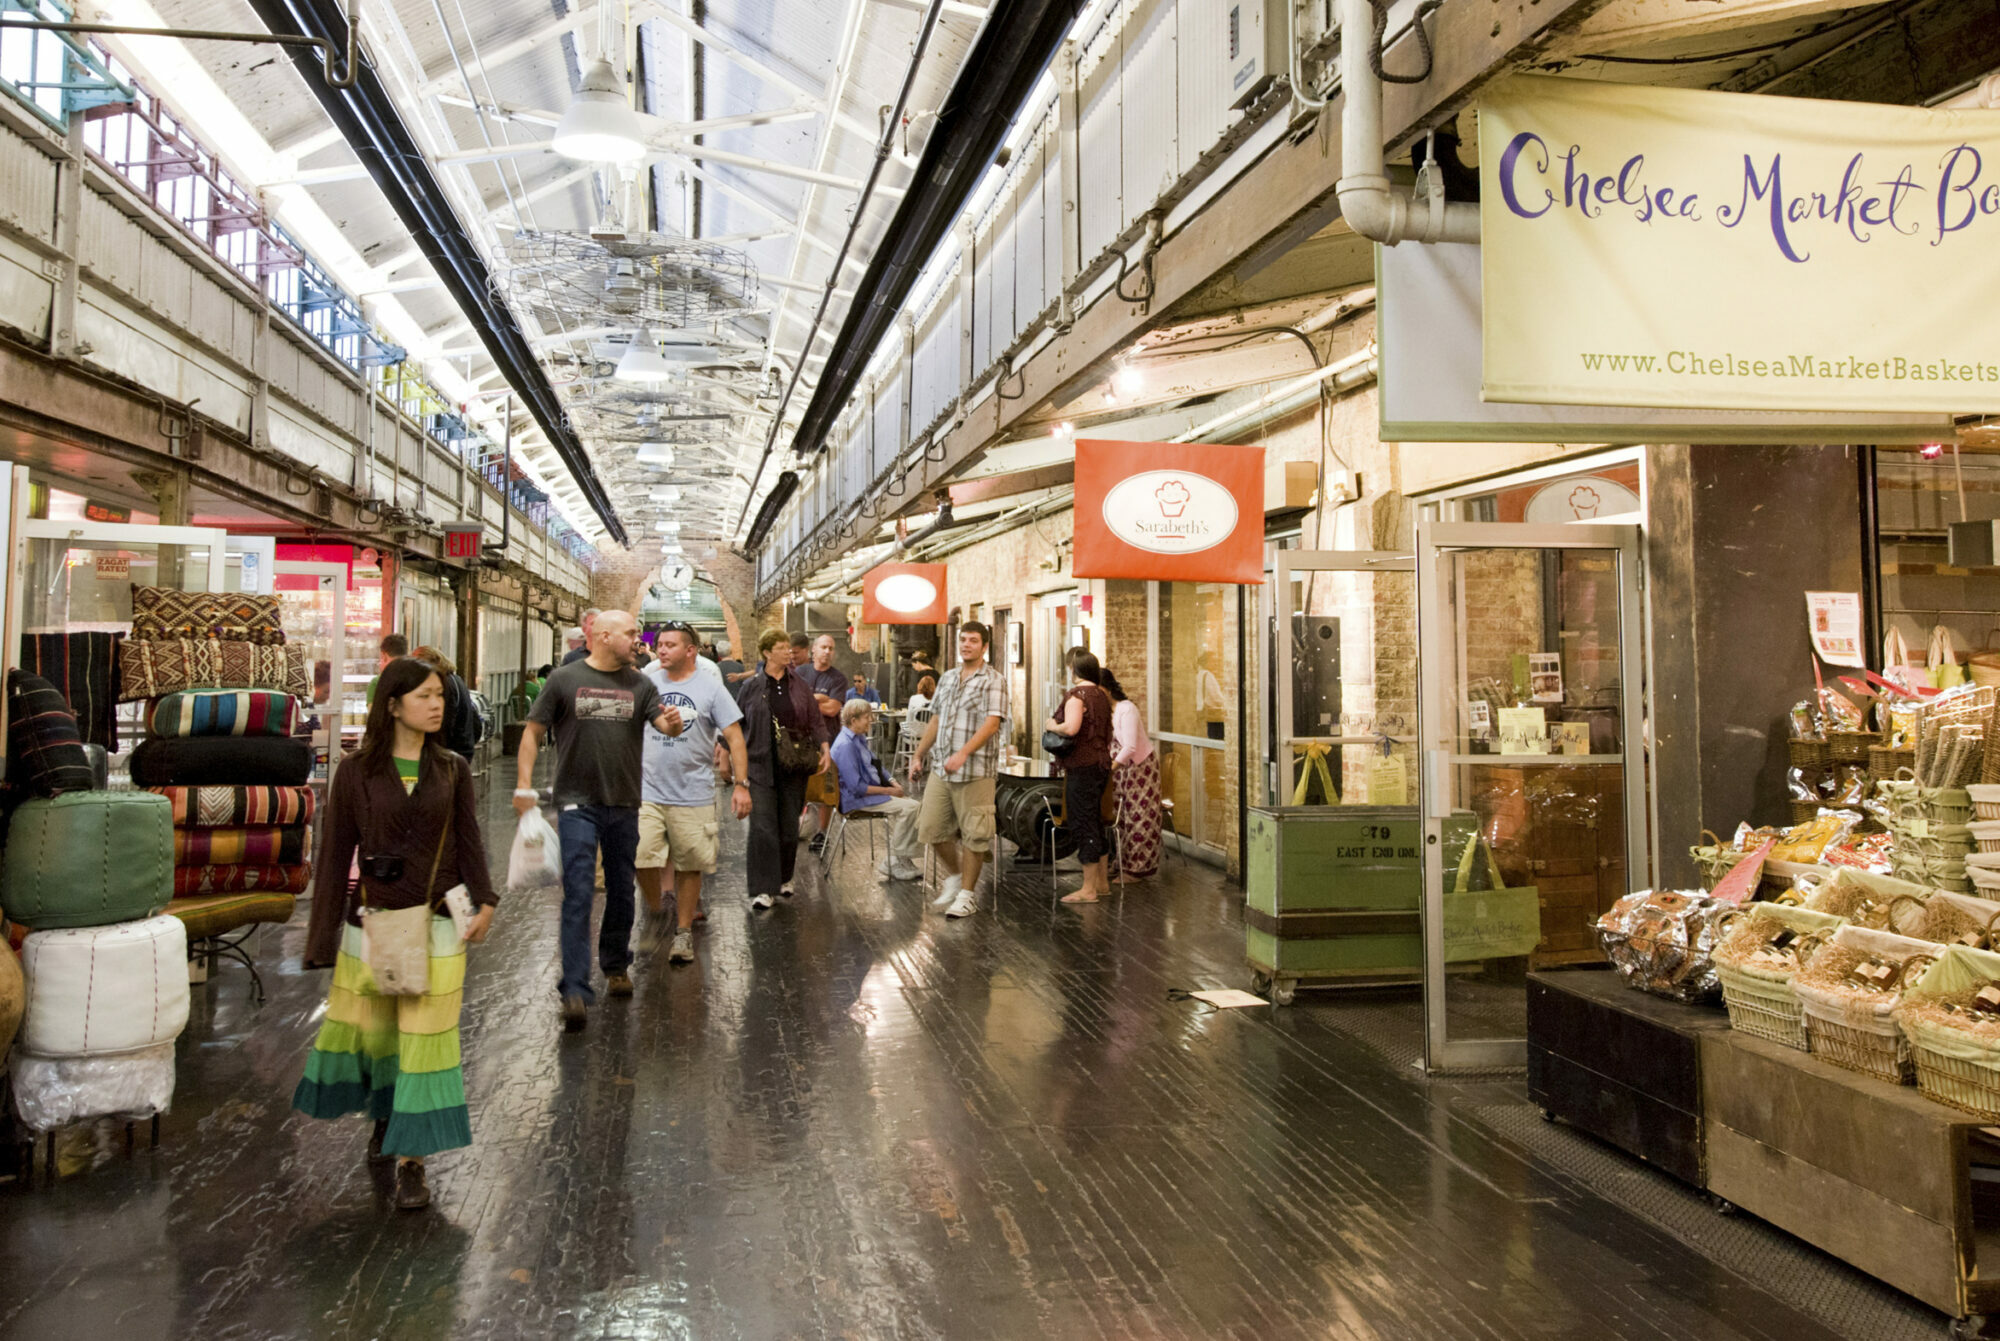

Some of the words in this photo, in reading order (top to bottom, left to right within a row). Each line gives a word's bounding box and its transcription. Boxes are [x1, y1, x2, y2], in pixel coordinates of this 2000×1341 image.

[1499, 131, 1702, 227] Chelsea
[1716, 152, 1928, 263] Market
[1135, 519, 1209, 535] Sarabeth's
[449, 532, 478, 557] EXIT
[1337, 847, 1366, 858] EAST
[1372, 847, 1394, 858] END
